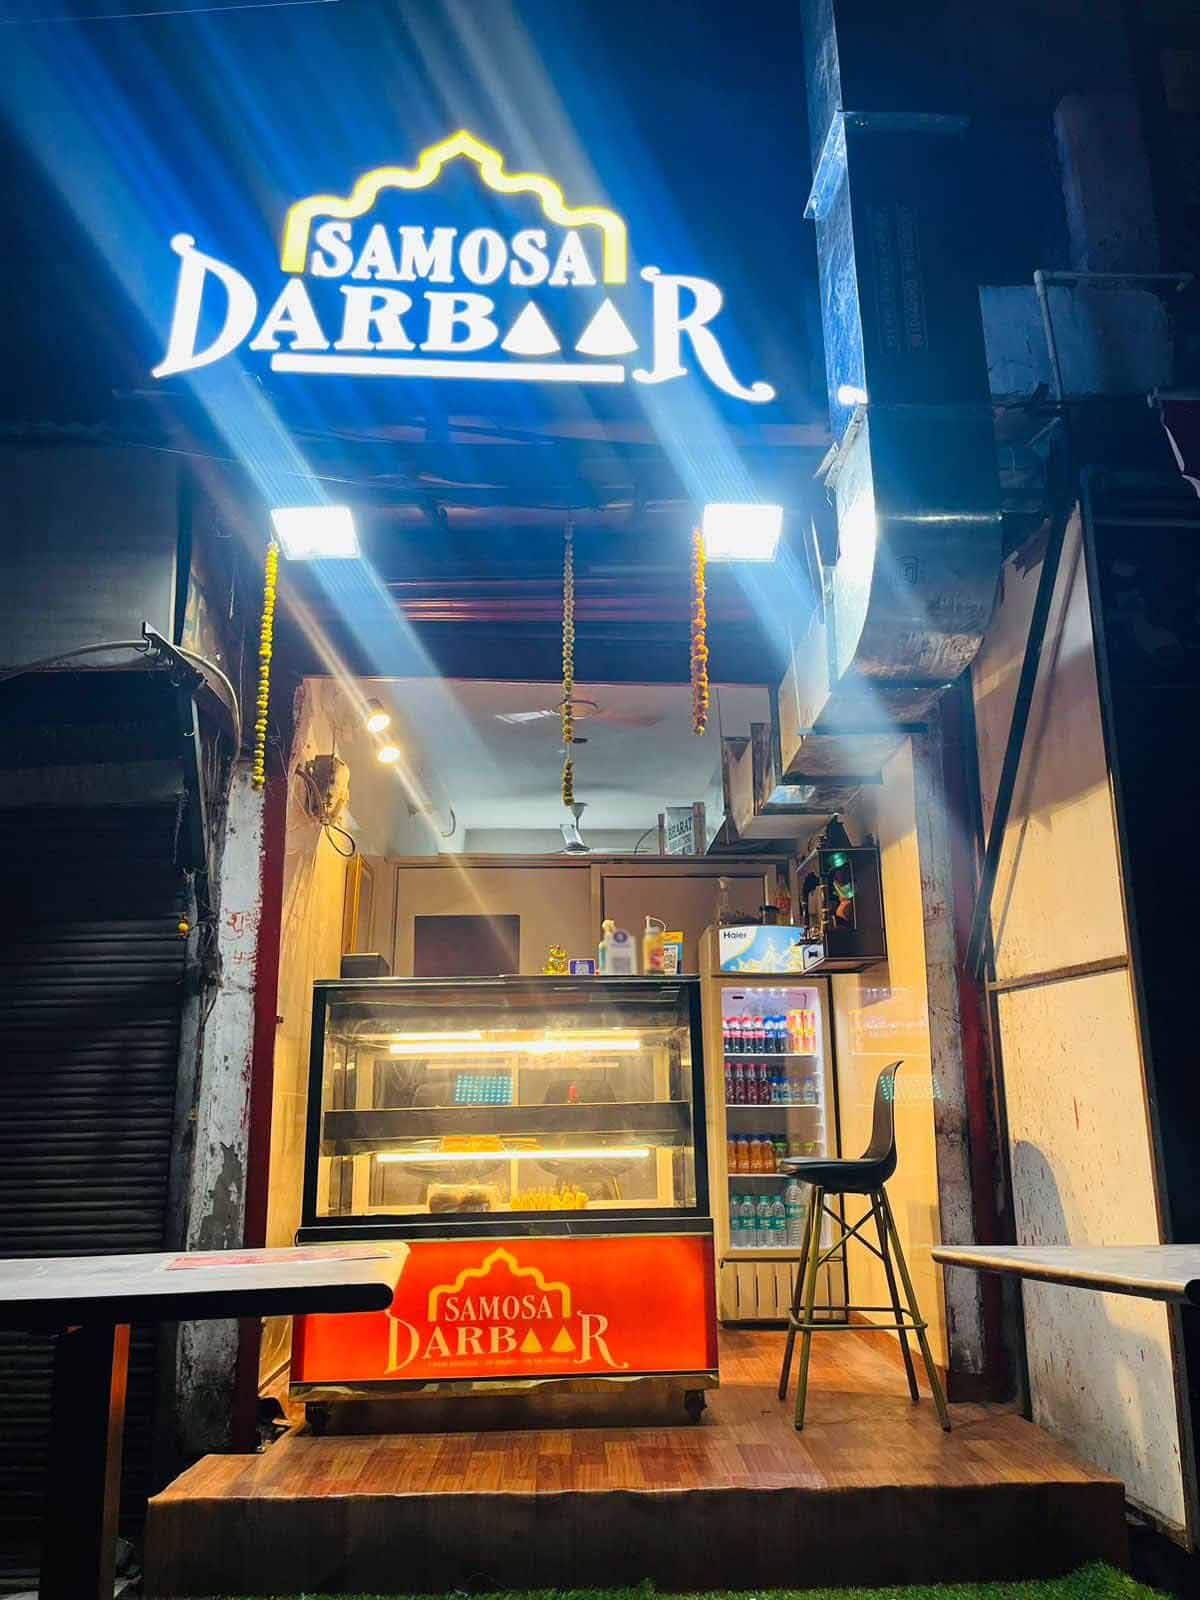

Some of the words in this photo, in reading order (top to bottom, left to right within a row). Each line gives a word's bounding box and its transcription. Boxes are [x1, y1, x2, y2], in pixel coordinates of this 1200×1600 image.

[311, 221, 597, 286] SAMOSA
[723, 931, 747, 939] Haier
[444, 1295, 553, 1322] SAMOSA
